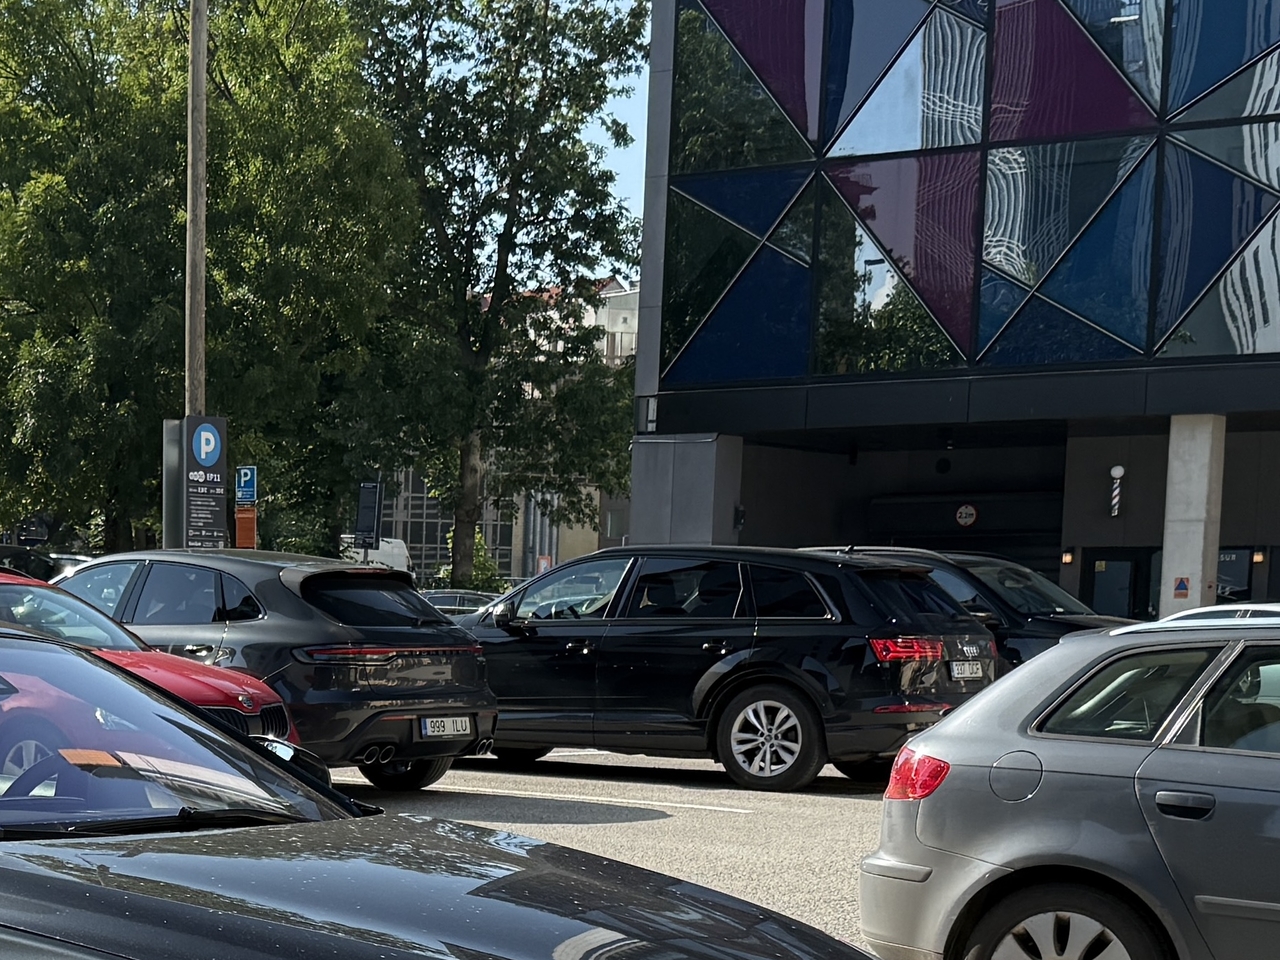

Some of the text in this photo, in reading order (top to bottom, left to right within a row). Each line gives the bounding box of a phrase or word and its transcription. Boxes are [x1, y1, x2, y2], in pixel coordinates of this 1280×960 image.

[201, 431, 216, 459] P
[240, 468, 252, 487] P
[430, 719, 468, 733] 999 ILU
